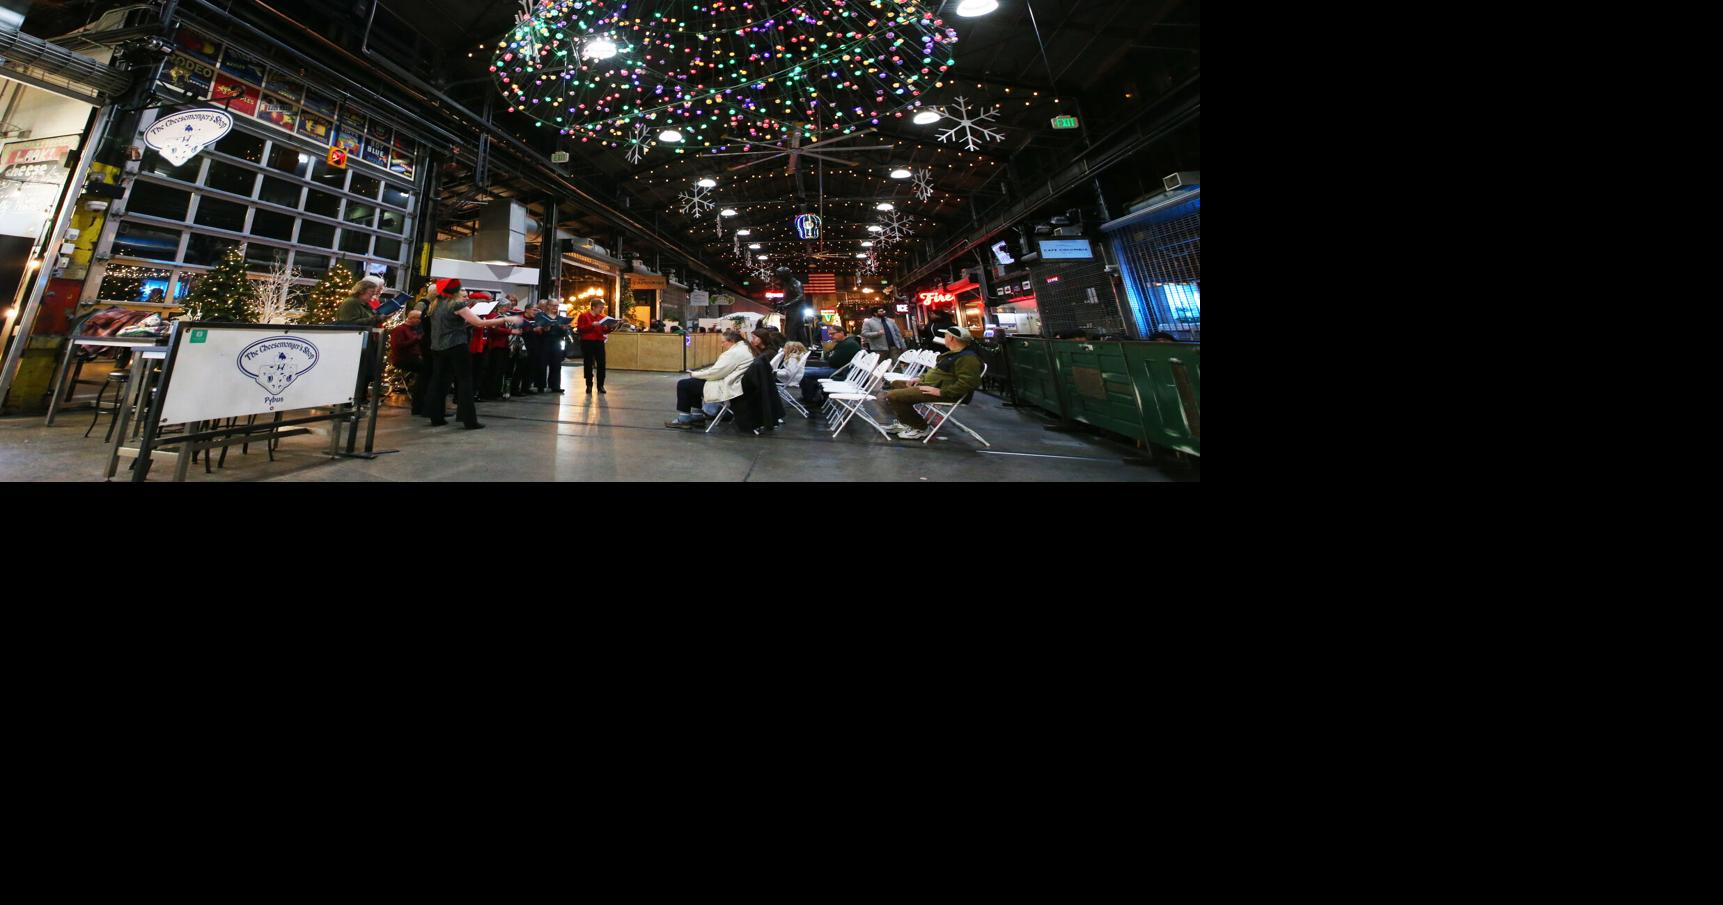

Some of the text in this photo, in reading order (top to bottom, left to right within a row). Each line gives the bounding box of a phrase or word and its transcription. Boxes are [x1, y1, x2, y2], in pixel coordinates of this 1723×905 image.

[150, 124, 165, 135] The
[213, 115, 227, 129] Shop
[1055, 117, 1076, 128] EXIT
[366, 145, 386, 158] BLUE
[919, 292, 955, 306] Fire
[244, 348, 260, 361] The
[301, 346, 315, 360] Shop
[264, 396, 284, 404] Pybus
